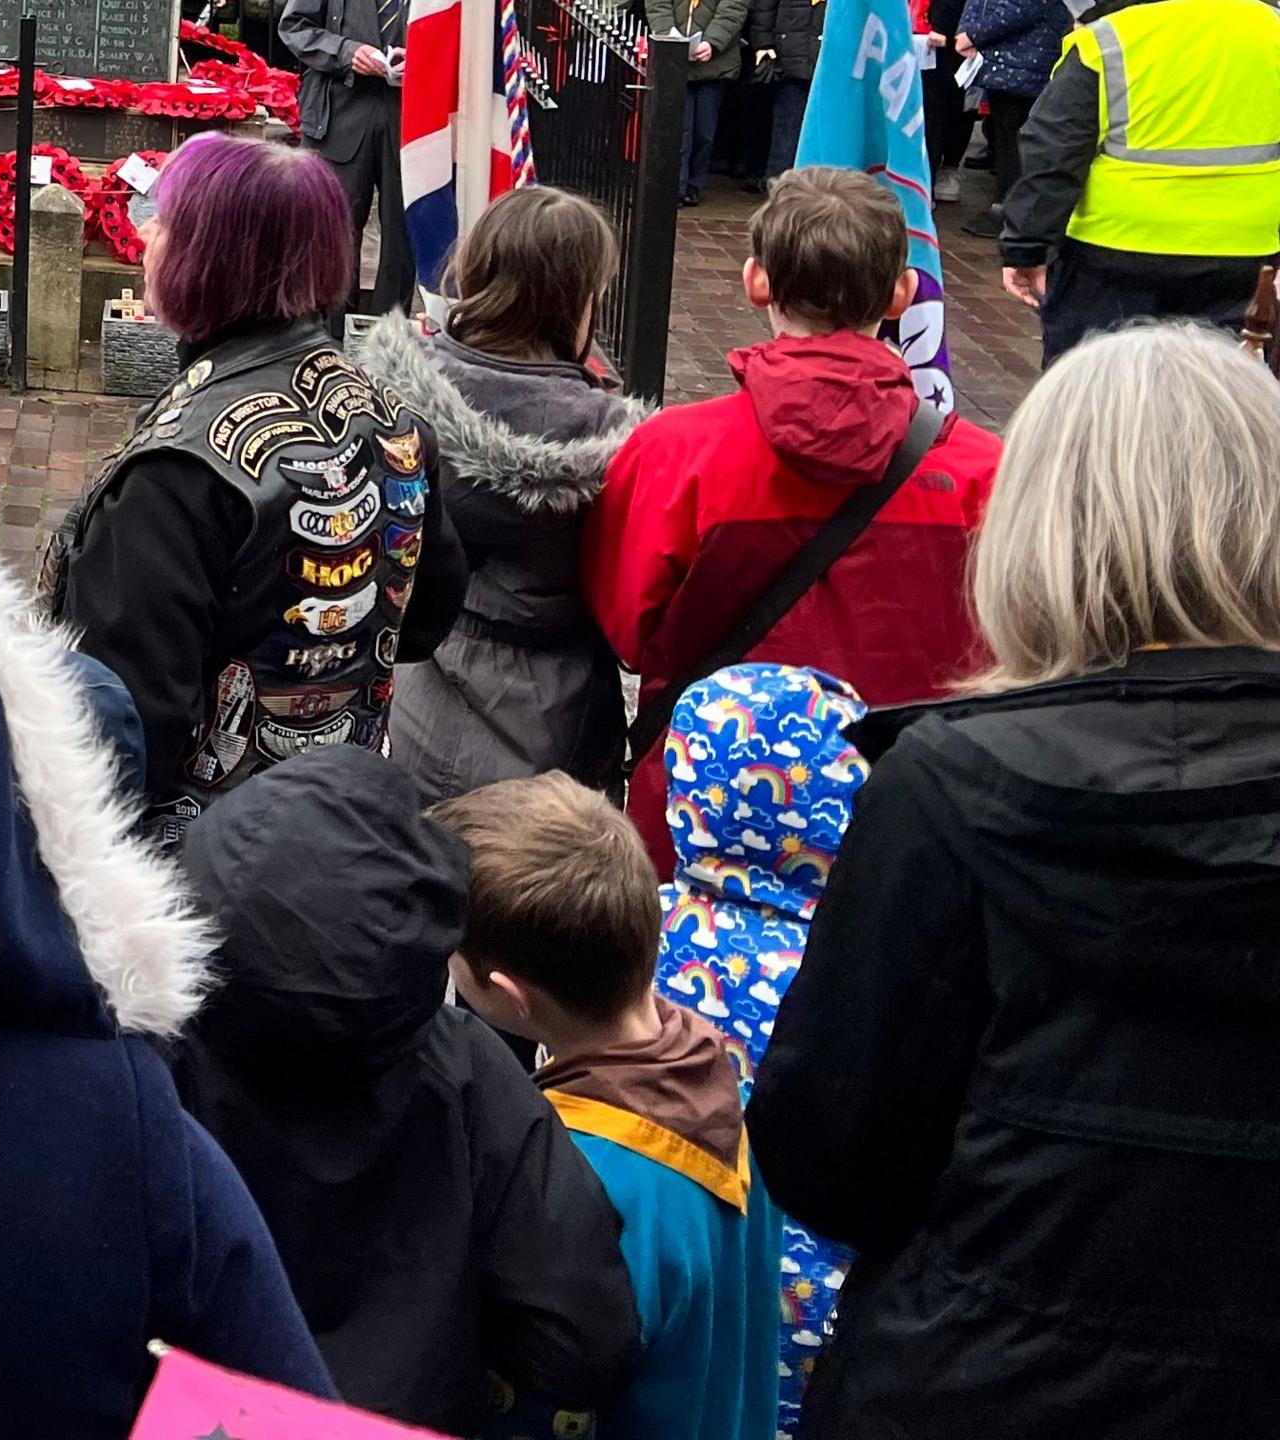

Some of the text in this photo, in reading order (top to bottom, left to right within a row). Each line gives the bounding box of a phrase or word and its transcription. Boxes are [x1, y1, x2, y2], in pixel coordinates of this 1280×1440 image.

[300, 367, 319, 390] LIFE
[215, 396, 280, 446] PAST DIRECTOR
[301, 550, 373, 587] HOG
